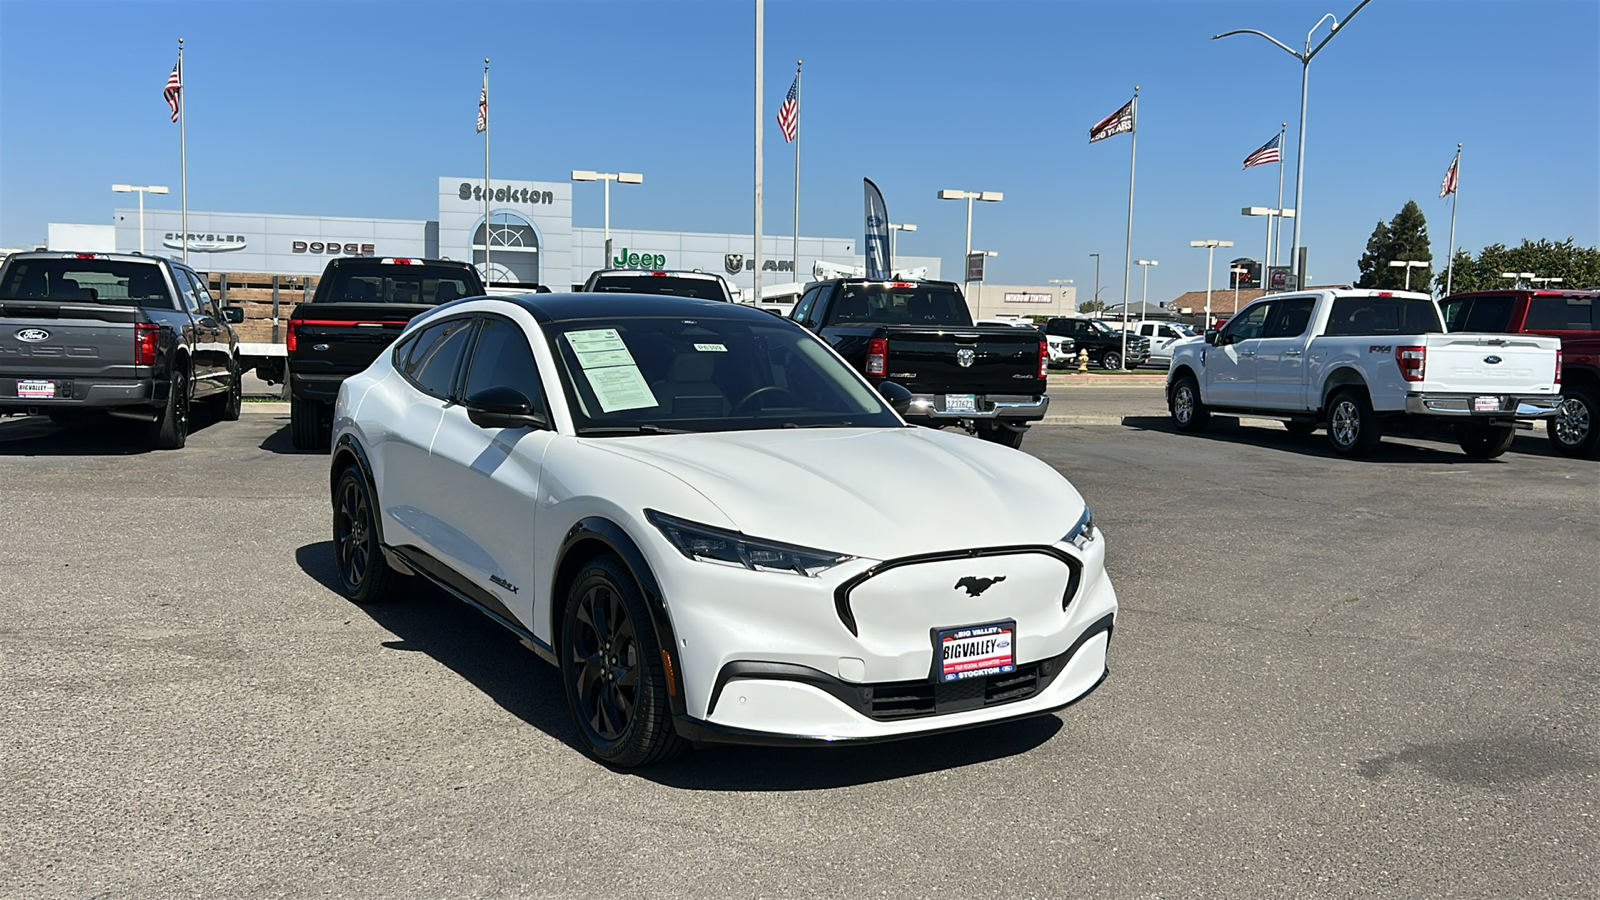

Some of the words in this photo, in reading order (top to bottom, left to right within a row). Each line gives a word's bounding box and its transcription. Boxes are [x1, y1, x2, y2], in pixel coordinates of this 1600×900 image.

[459, 183, 553, 204] Stockton
[164, 233, 246, 242] CHRYSLER
[292, 241, 375, 254] DODGE
[613, 248, 666, 269] Jeep
[1005, 294, 1030, 302] WINDOW
[1030, 294, 1052, 303] TINTING
[22, 329, 44, 339] Ford
[958, 630, 971, 638] BIG
[972, 627, 998, 636] VALLEY
[943, 638, 997, 660] BIGVALLEY
[958, 667, 1000, 679] STOCKTON
